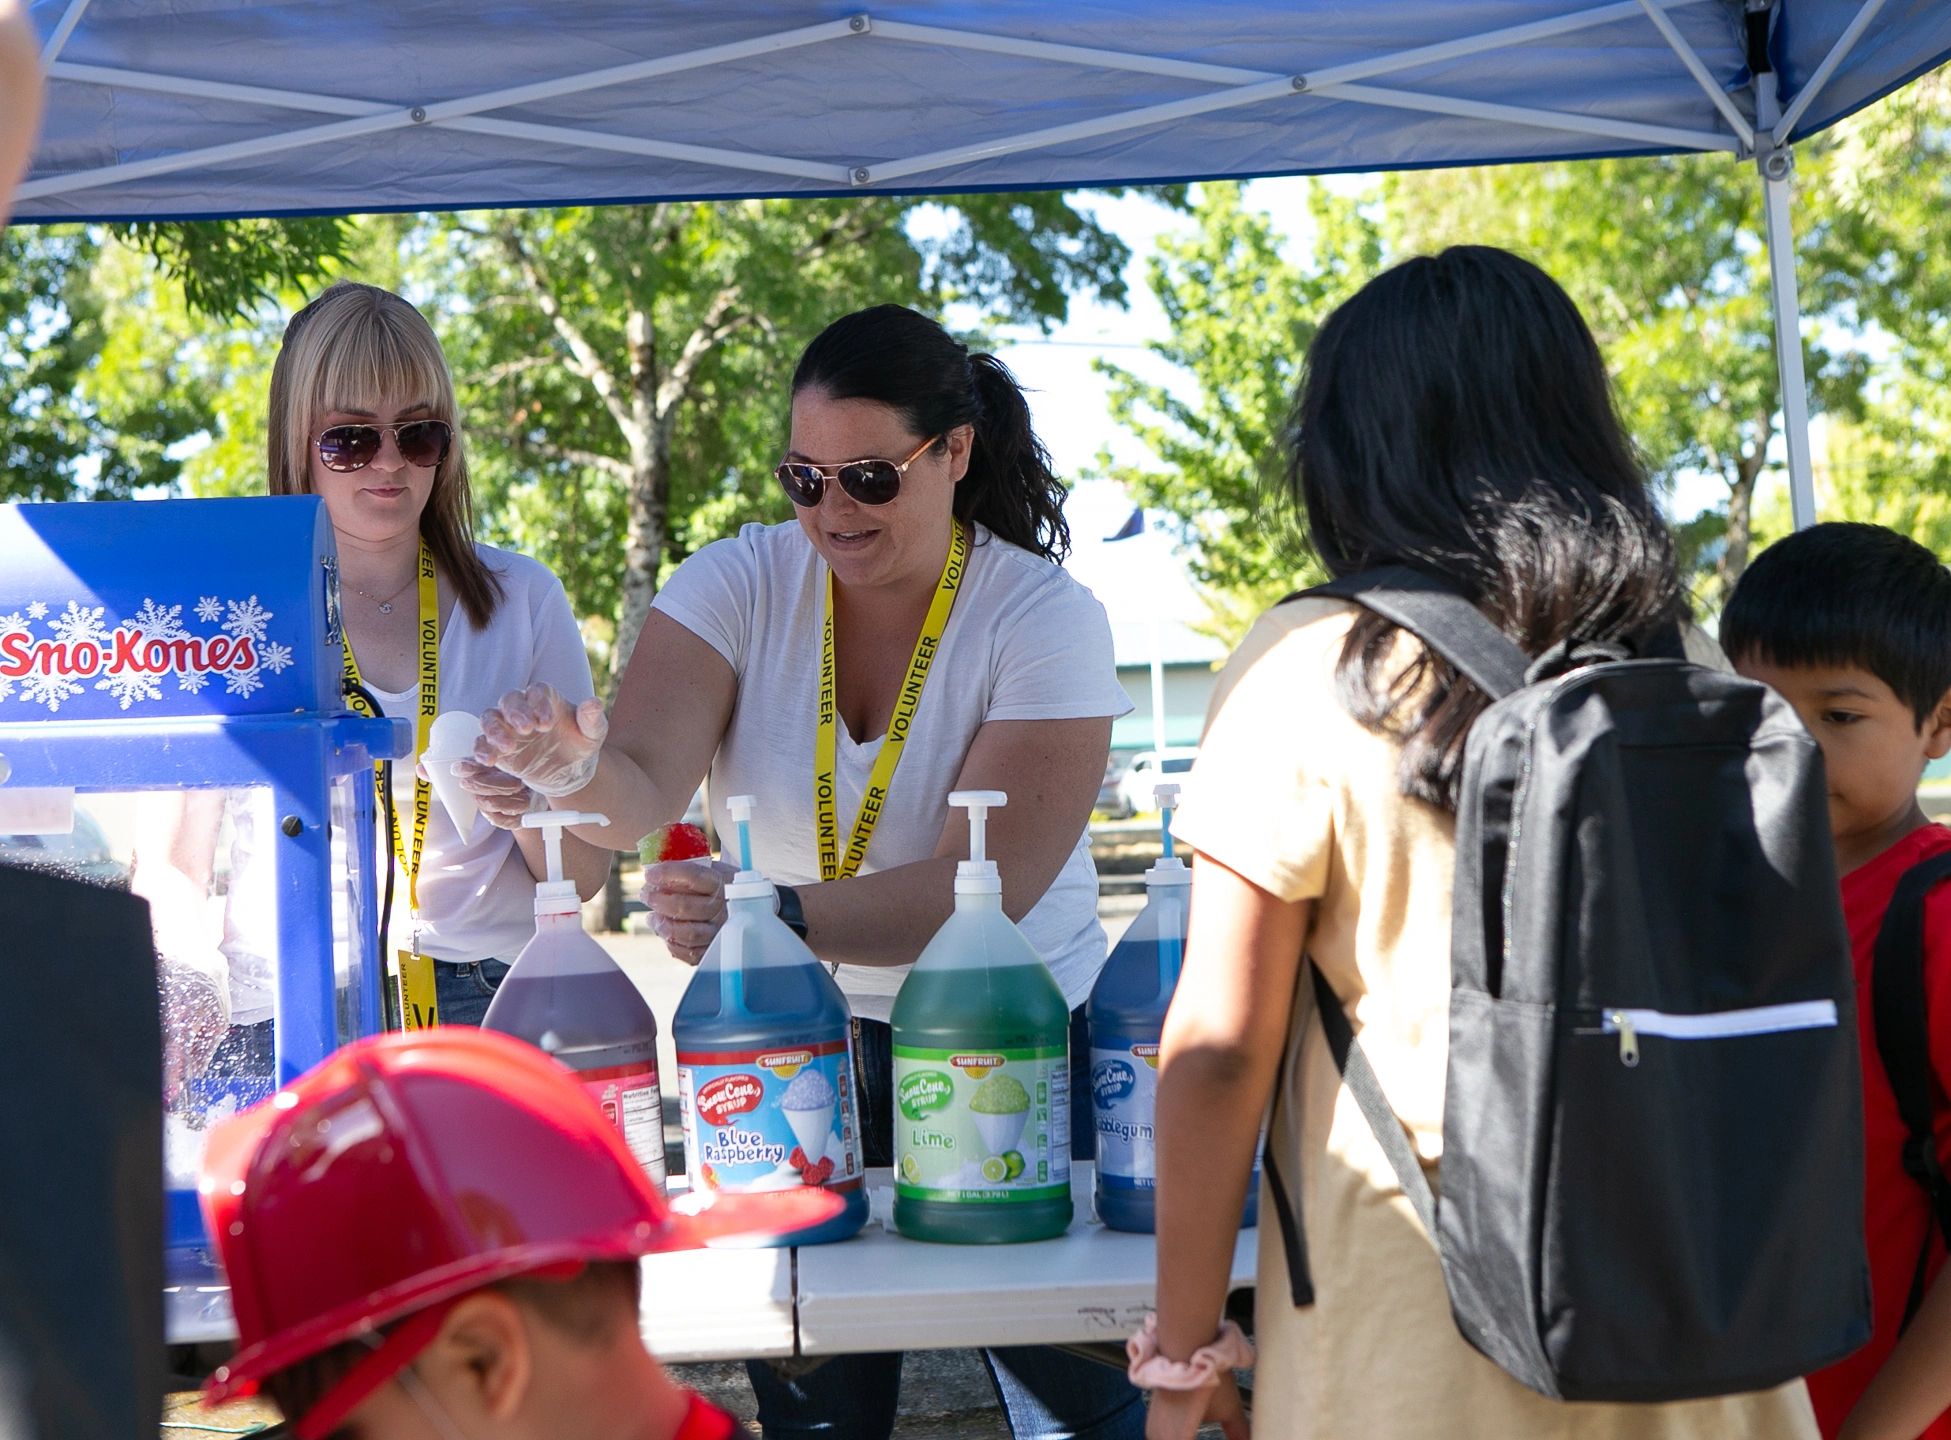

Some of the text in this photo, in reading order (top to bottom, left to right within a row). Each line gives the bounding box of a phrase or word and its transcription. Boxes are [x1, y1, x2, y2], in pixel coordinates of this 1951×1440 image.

[0, 629, 256, 676] Sno-Kones
[422, 619, 437, 716] VOLUNTEER
[821, 616, 833, 725] VOLUNTEER
[890, 636, 938, 742] VOLUNTEER
[764, 1055, 805, 1067] SUNFRUIT
[956, 1057, 998, 1066] SUNFRUIT
[725, 1082, 754, 1101] Cone
[920, 1079, 945, 1095] Cone
[716, 1097, 747, 1115] SYRUP
[718, 1129, 761, 1148] Blue
[912, 1130, 953, 1149] Lime
[706, 1145, 784, 1164] Raspberry
